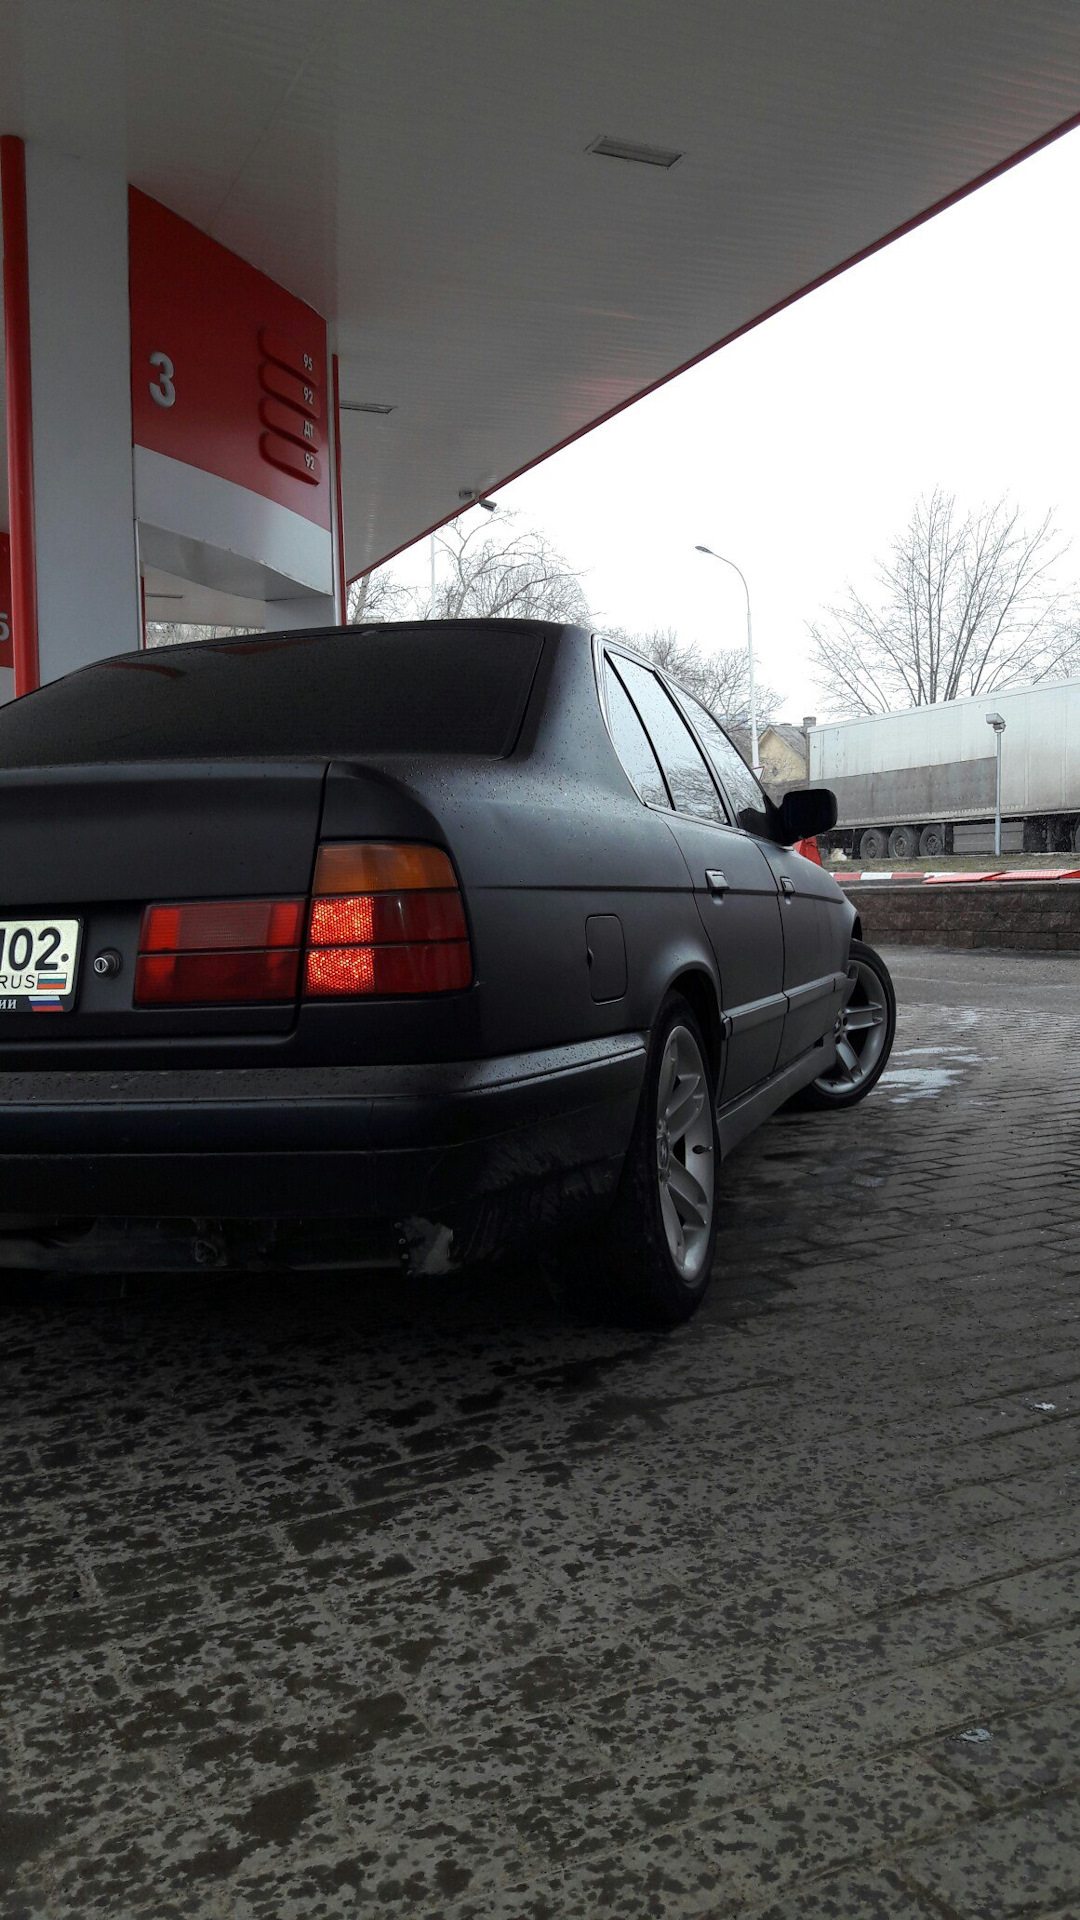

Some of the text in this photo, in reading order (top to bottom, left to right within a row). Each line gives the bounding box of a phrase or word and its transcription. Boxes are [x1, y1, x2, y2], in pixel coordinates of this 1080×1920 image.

[303, 353, 313, 372] 95
[149, 351, 176, 408] 3
[303, 386, 313, 405] 92
[304, 420, 314, 438] ДТ
[305, 453, 315, 471] 92
